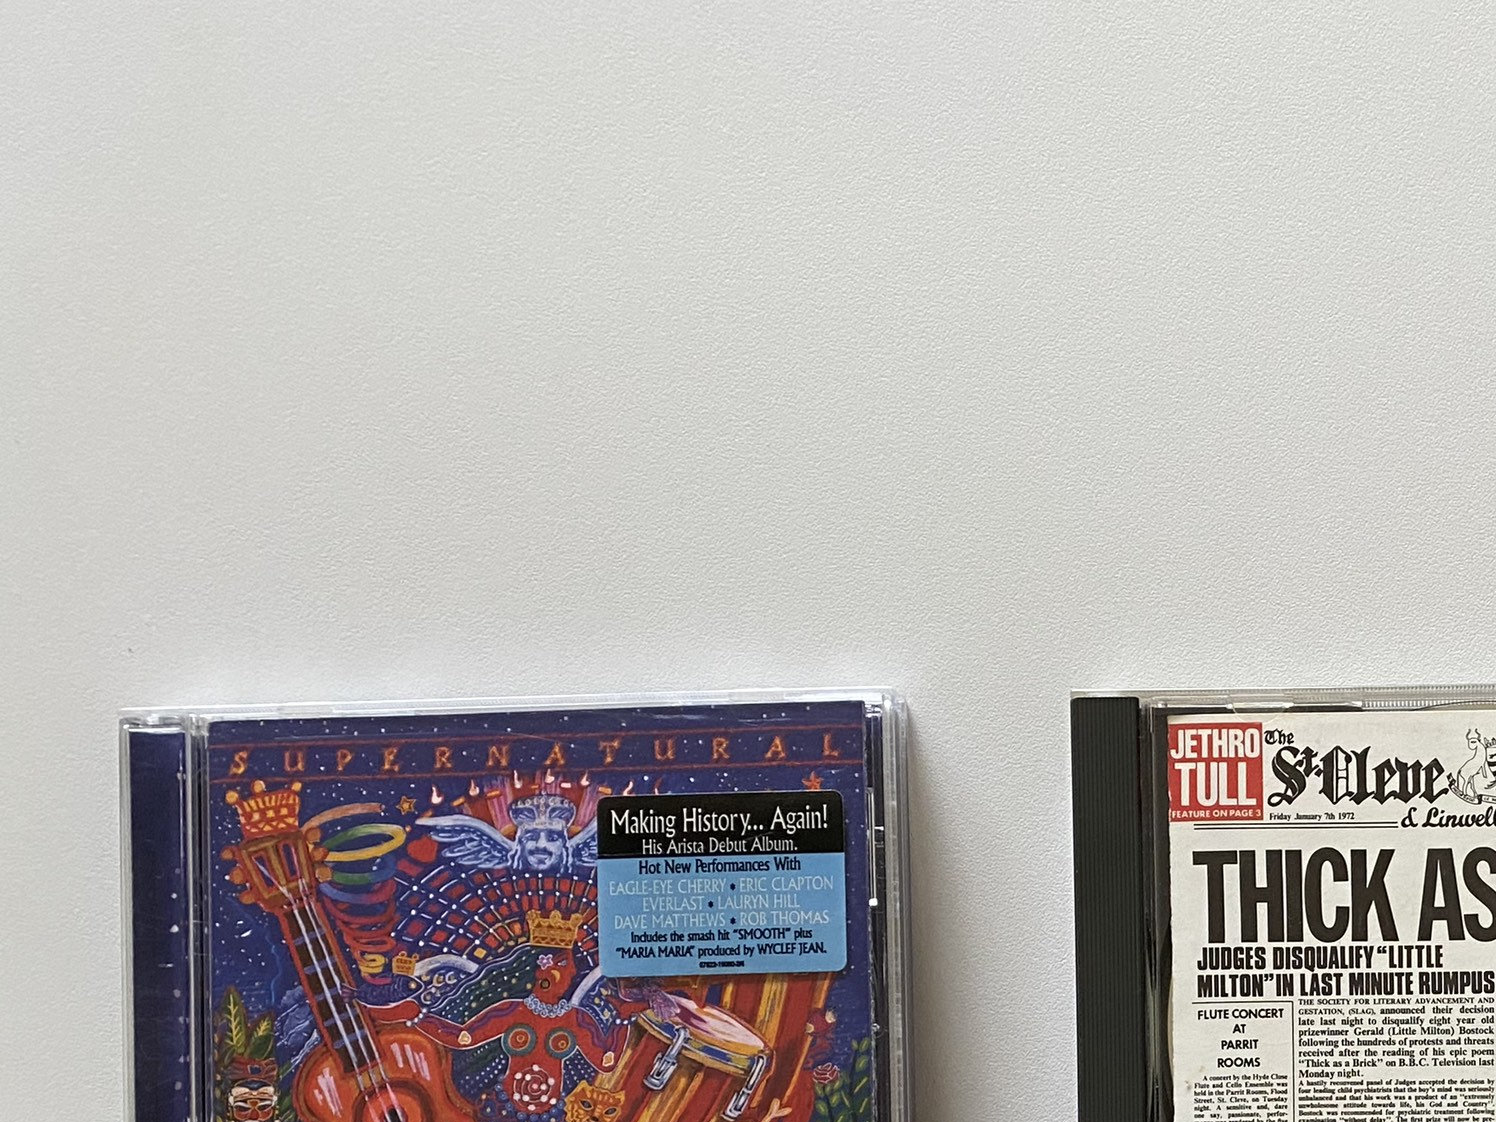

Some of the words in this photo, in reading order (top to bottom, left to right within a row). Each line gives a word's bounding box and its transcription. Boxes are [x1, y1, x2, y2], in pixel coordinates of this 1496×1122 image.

[1170, 728, 1260, 759] JETHRO
[1264, 729, 1294, 745] The
[230, 735, 841, 775] SUPERNATURAL
[1319, 746, 1451, 805] Cleve
[1175, 762, 1256, 806] TULL
[611, 809, 676, 837] Making
[771, 804, 828, 834] Again!
[1172, 810, 1210, 819] FEATURE
[1213, 810, 1227, 818] ON
[1229, 809, 1253, 817] PAGE
[1269, 813, 1291, 821] Friday
[1294, 813, 1321, 821] January
[1324, 812, 1335, 820] 7th
[1401, 808, 1417, 827] &
[642, 840, 662, 854] His
[667, 839, 703, 854] Arista
[709, 838, 747, 853] Debut
[751, 837, 798, 852] Album.
[639, 861, 660, 874] Hot
[665, 860, 691, 873] New
[695, 858, 769, 873] Performances
[774, 857, 801, 870] With
[609, 880, 673, 895] EAGLE-EYE
[678, 879, 726, 893] CHERRY
[740, 878, 766, 892] ERIC
[771, 876, 833, 891] CLAPTON
[643, 897, 705, 911] EVERLAST
[718, 895, 769, 910] LAURYN
[774, 894, 800, 908] HILL
[1193, 847, 1399, 943] THICK
[615, 915, 647, 929] DAVE
[652, 914, 725, 928] MATTHEWS
[740, 912, 767, 926] ROB
[771, 910, 829, 925] THOMAS
[631, 931, 666, 942] Includes
[671, 930, 684, 942] the
[687, 929, 714, 941] smash
[718, 929, 730, 940] hit
[794, 928, 812, 941] plus
[698, 945, 740, 958] produced
[743, 944, 755, 957] by
[758, 942, 796, 955] WYCLEF
[799, 942, 826, 955] JEAN.
[1197, 947, 1266, 971] JUDGES
[1273, 946, 1373, 971] DISQUALIFY
[1276, 974, 1294, 996] IN
[1301, 973, 1343, 996] LAST
[1349, 972, 1413, 995] MINUTE
[1419, 971, 1495, 995] RUMPUS
[1198, 1009, 1229, 1020] FLUTE
[1232, 1008, 1284, 1018] CONCERT
[1379, 1006, 1425, 1014] announced
[1432, 1006, 1453, 1014] their
[1459, 1005, 1494, 1013] decision
[1233, 1024, 1246, 1033] AT
[1298, 1017, 1314, 1025] late
[1320, 1017, 1335, 1025] last
[1341, 1017, 1363, 1028] night
[1382, 1017, 1424, 1027] disqualify
[1429, 1017, 1450, 1027] eight
[1456, 1019, 1475, 1027] year
[1481, 1016, 1494, 1024] old
[1298, 1027, 1349, 1038] prizewinner
[1353, 1027, 1384, 1035] Gerald
[1387, 1027, 1416, 1037] (Little
[1420, 1027, 1454, 1037] Milton)
[1458, 1027, 1494, 1035] Bostock
[1221, 1039, 1258, 1050] PARRIT
[1298, 1038, 1339, 1049] following
[1341, 1038, 1355, 1046] the
[1356, 1038, 1396, 1046] hundreds
[1398, 1038, 1408, 1046] of
[1408, 1039, 1443, 1048] protests
[1463, 1037, 1494, 1045] threats
[1298, 1049, 1334, 1057] received
[1338, 1048, 1359, 1056] after
[1364, 1048, 1377, 1056] the
[1382, 1048, 1414, 1059] reading
[1419, 1048, 1428, 1056] of
[1432, 1048, 1445, 1056] his
[1449, 1048, 1467, 1058] epic
[1471, 1050, 1494, 1058] poem
[1218, 1058, 1260, 1068] ROOMS
[1398, 1059, 1429, 1067] B.B.C.
[1431, 1058, 1476, 1066] Television
[1478, 1058, 1494, 1066] last
[1298, 1069, 1334, 1080] Monday
[1337, 1069, 1363, 1080] night.
